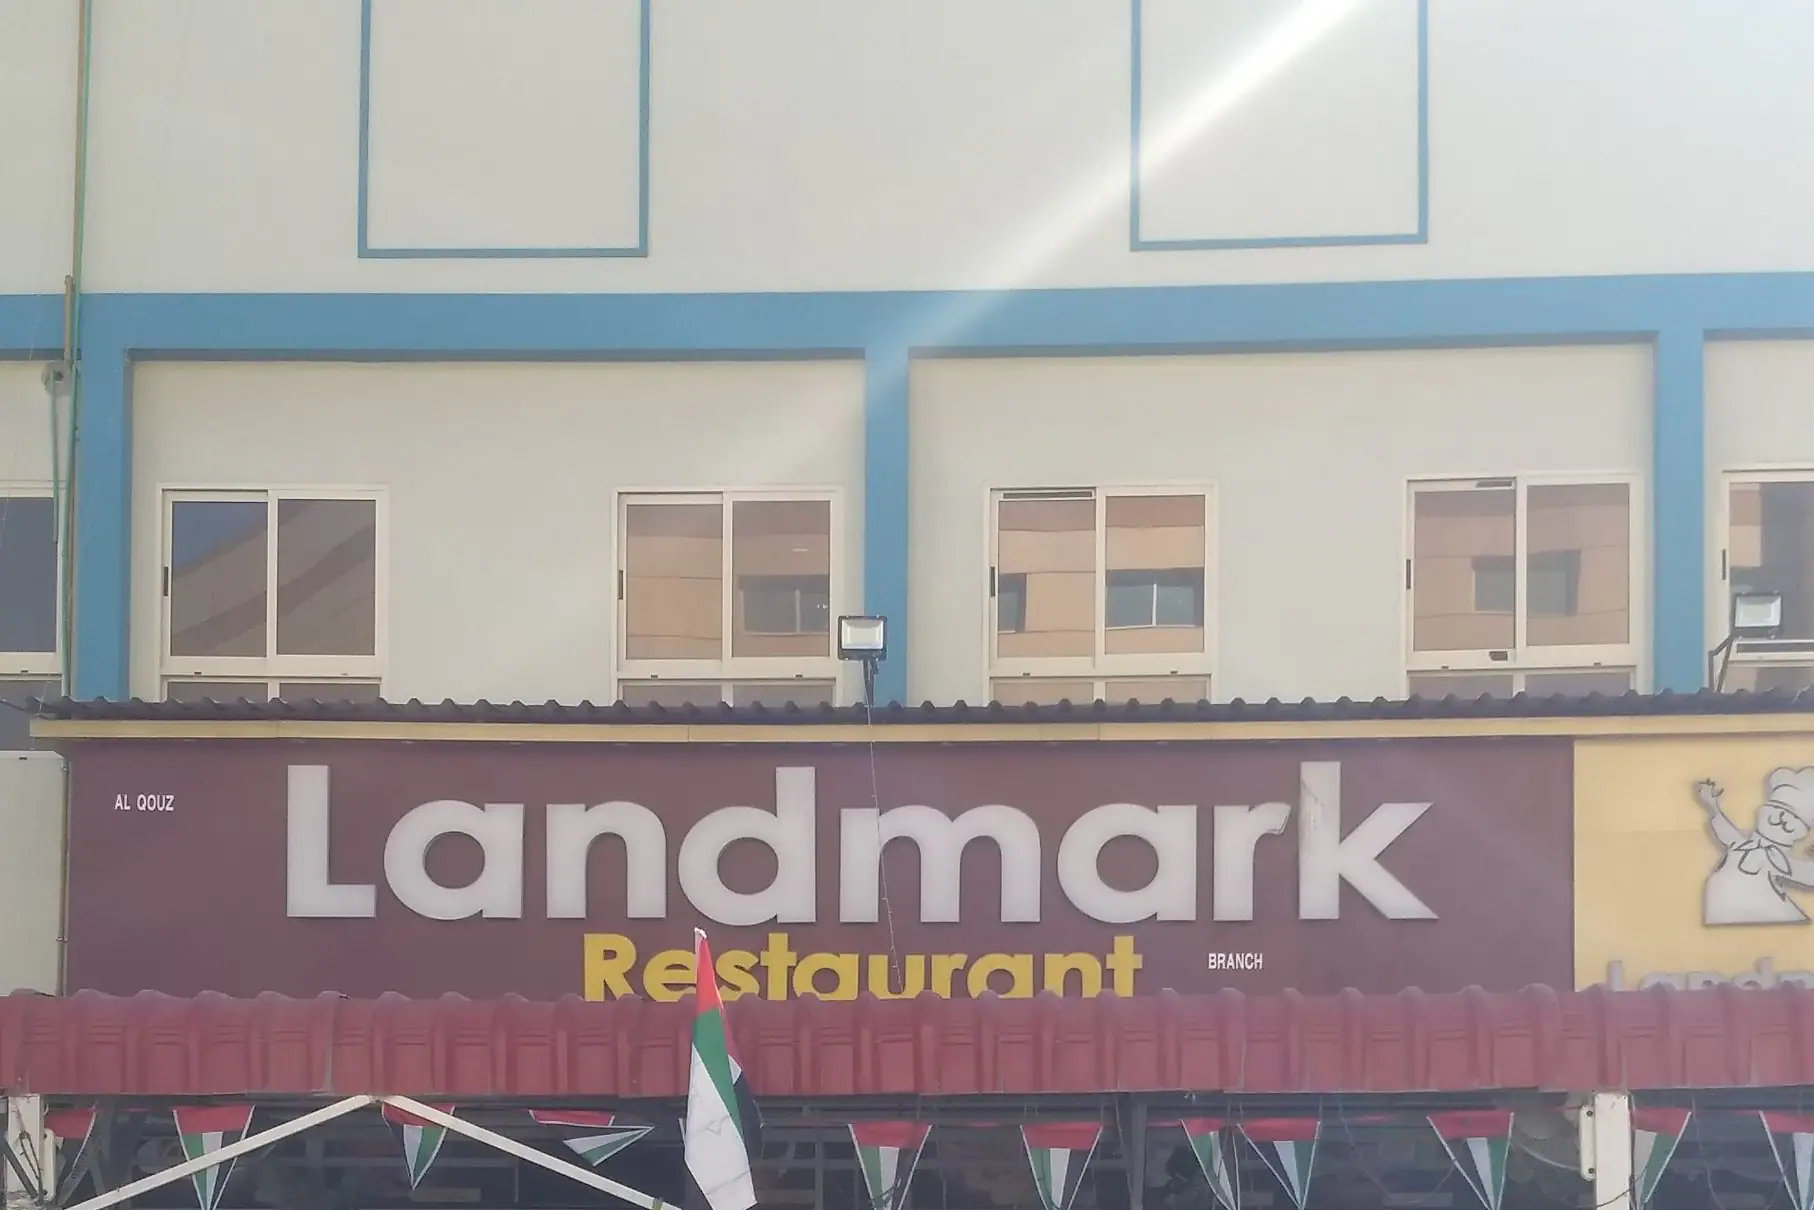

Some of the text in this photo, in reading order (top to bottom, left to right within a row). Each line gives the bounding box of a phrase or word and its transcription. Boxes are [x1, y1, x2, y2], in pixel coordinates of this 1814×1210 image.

[114, 793, 175, 811] AL QOUZ
[287, 761, 1439, 926] Landmark
[583, 932, 1144, 1003] Restaurant
[1208, 952, 1263, 970] BRANCH
